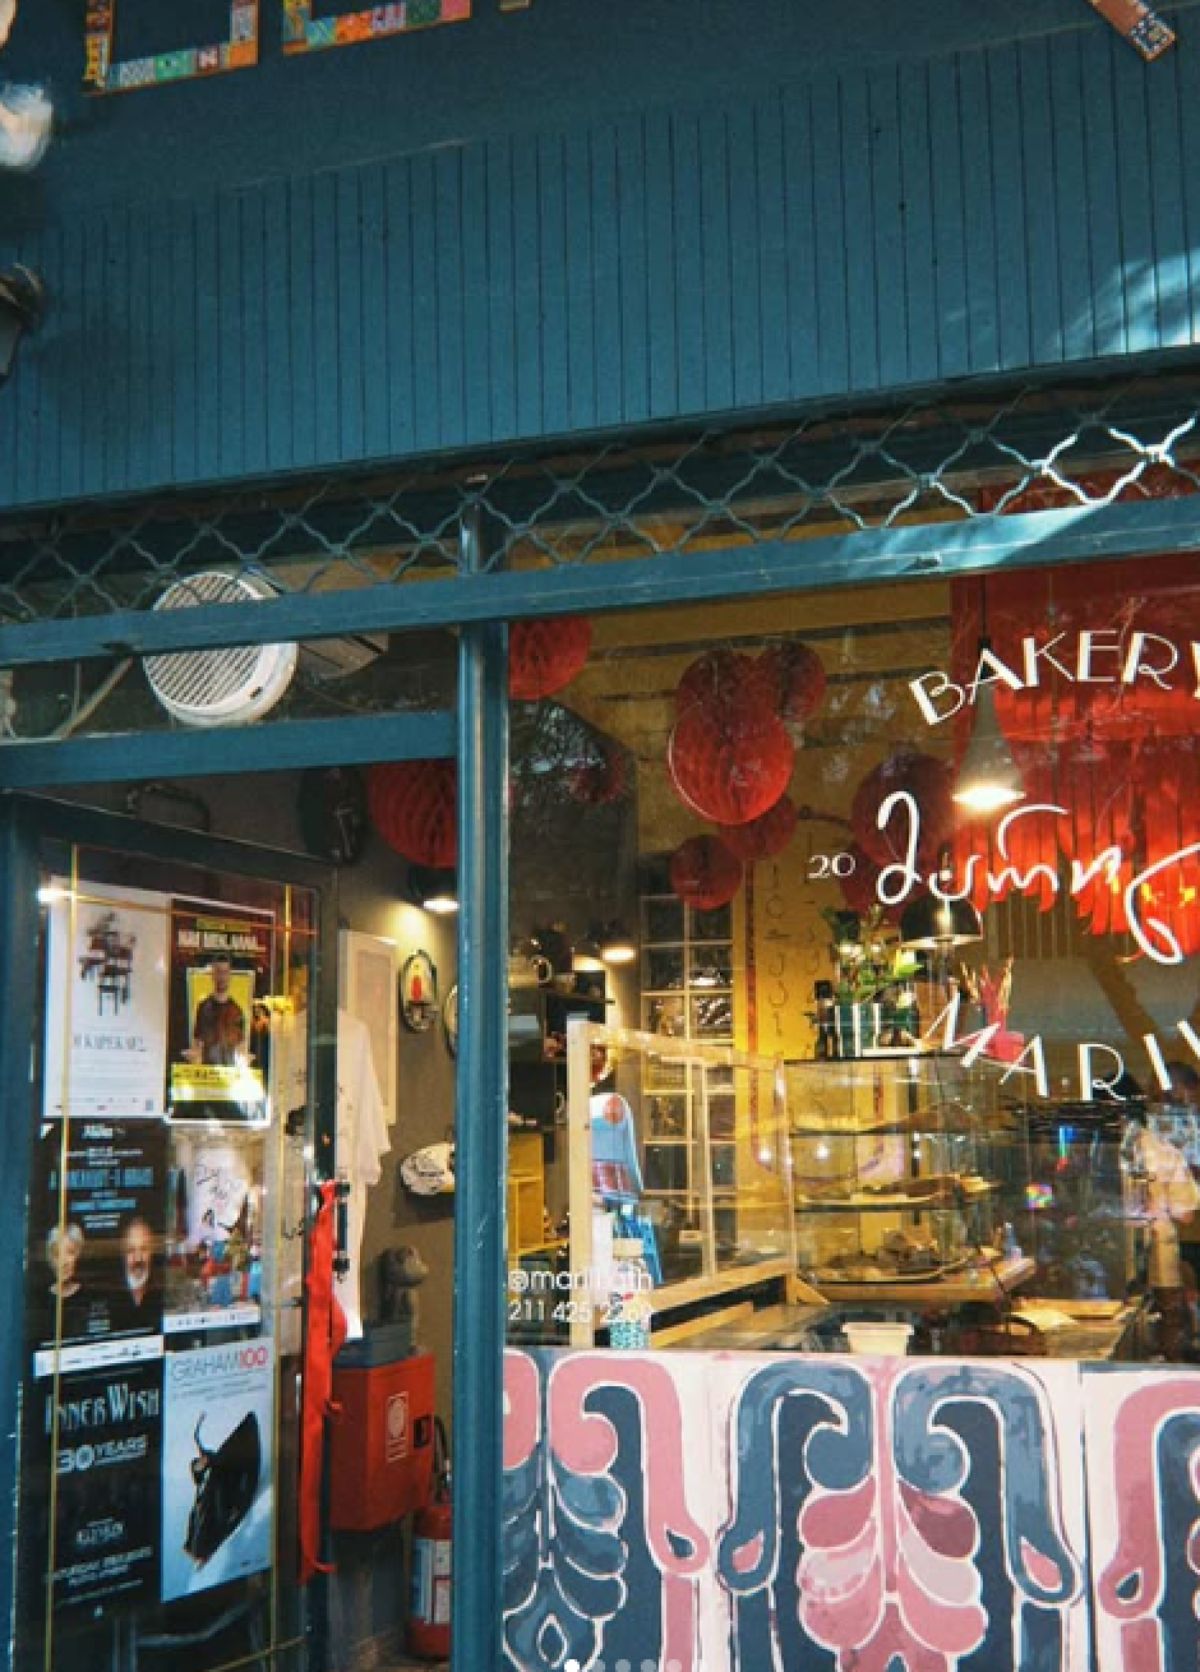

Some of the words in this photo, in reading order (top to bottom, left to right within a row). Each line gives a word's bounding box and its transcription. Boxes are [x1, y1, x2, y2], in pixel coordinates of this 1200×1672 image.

[908, 629, 1200, 726] BAKER
[808, 852, 856, 879] 20
[508, 1300, 545, 1321] 211
[55, 1444, 95, 1474] 30
